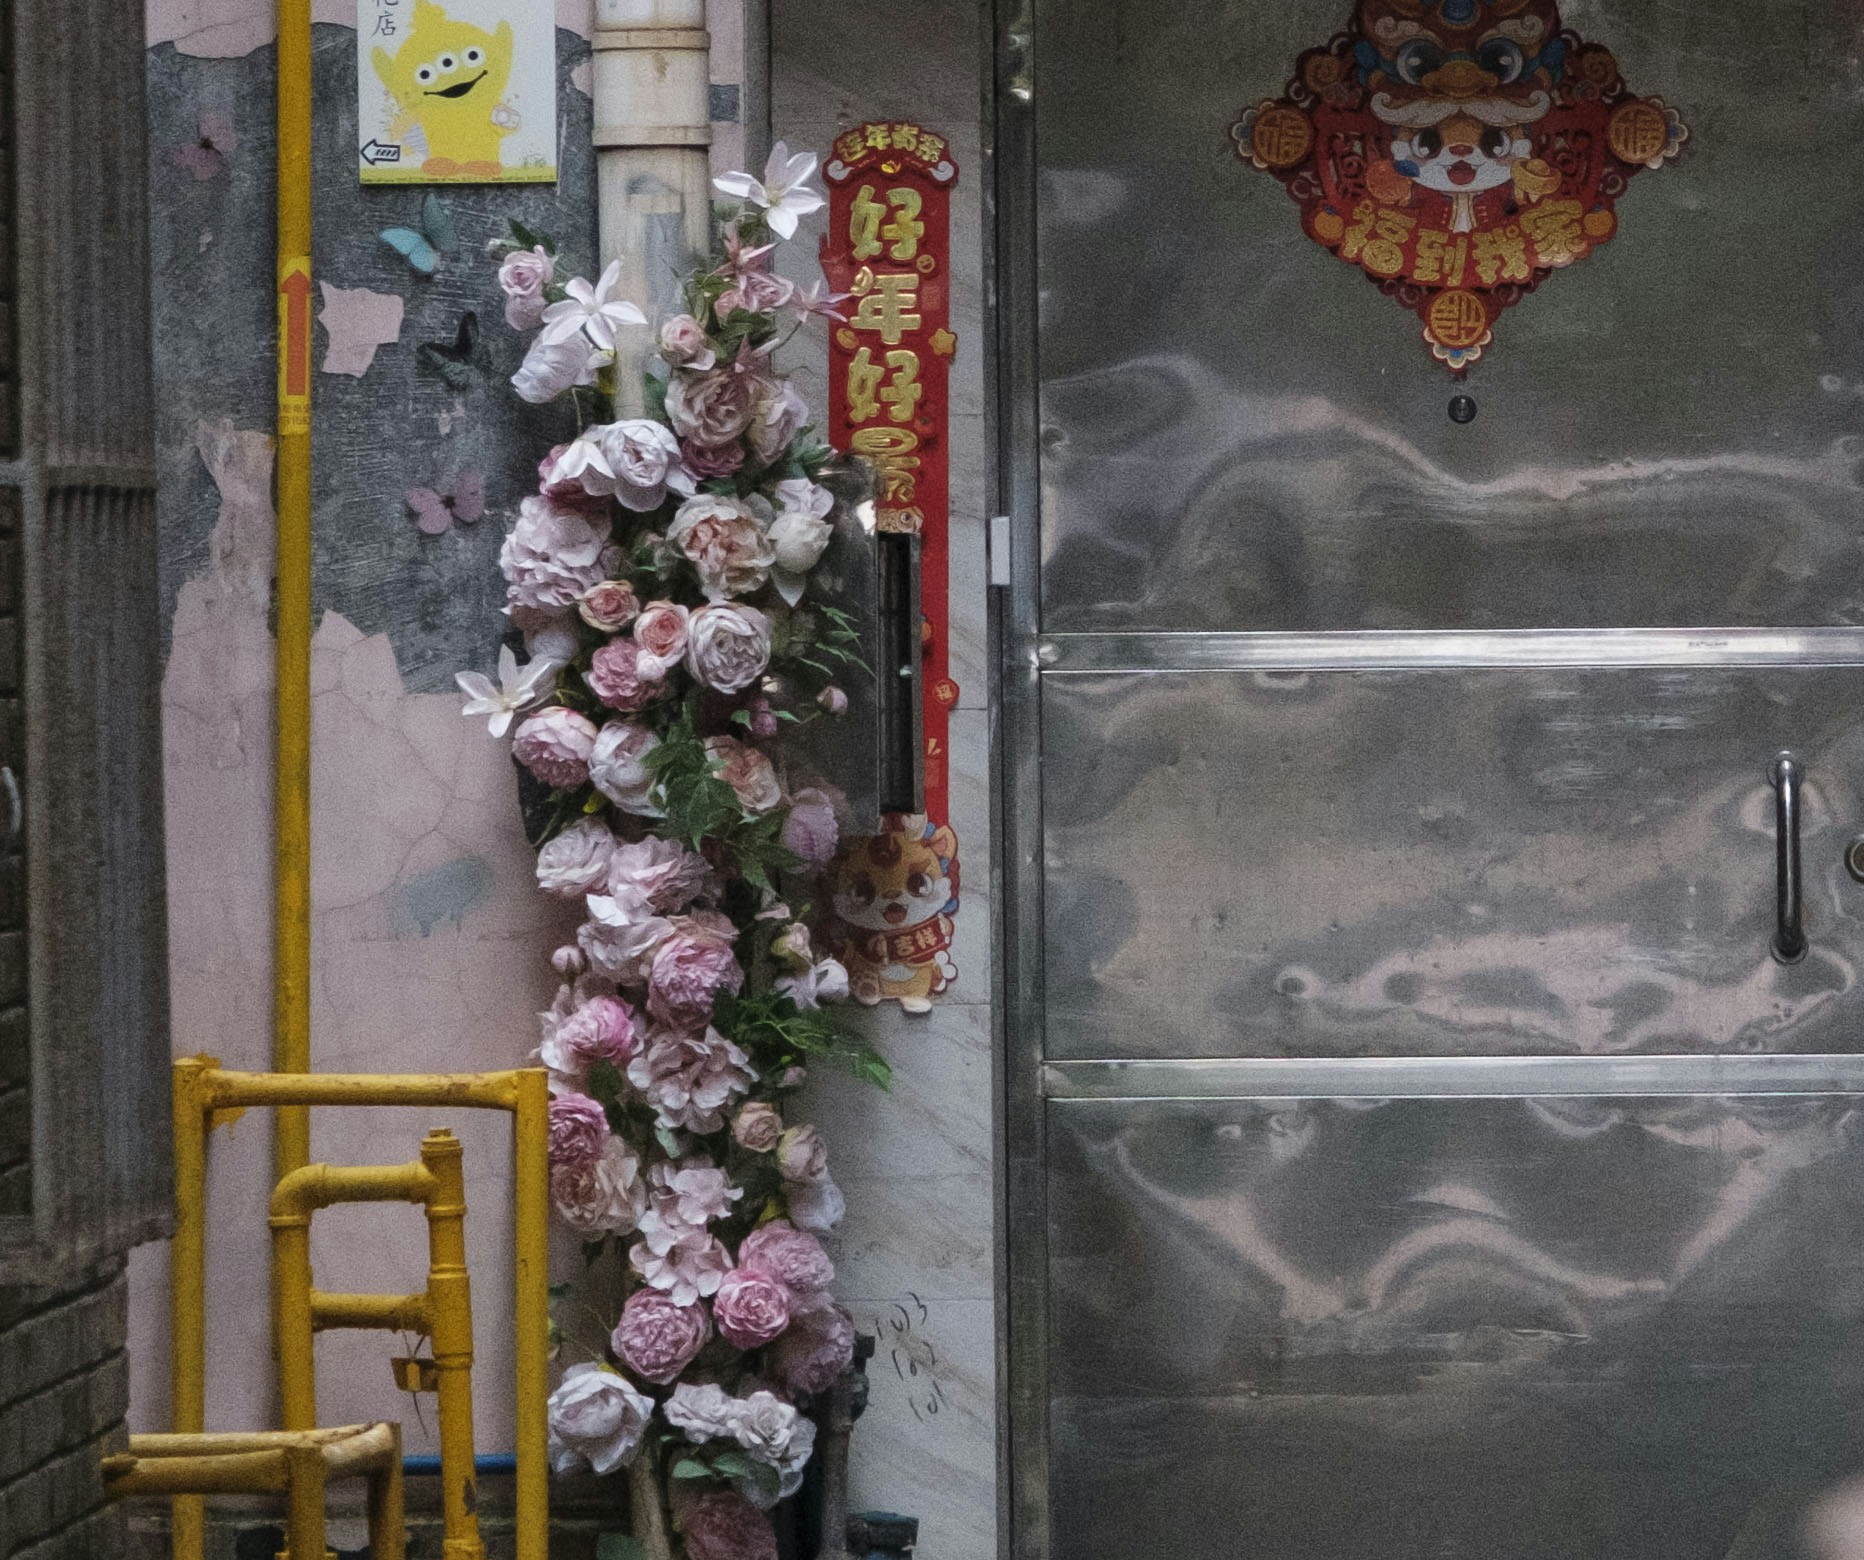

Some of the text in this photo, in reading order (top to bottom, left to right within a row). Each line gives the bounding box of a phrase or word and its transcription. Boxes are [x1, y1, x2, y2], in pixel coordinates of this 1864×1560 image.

[1343, 198, 1589, 287] 福到我家
[894, 926, 938, 957] 吉祥
